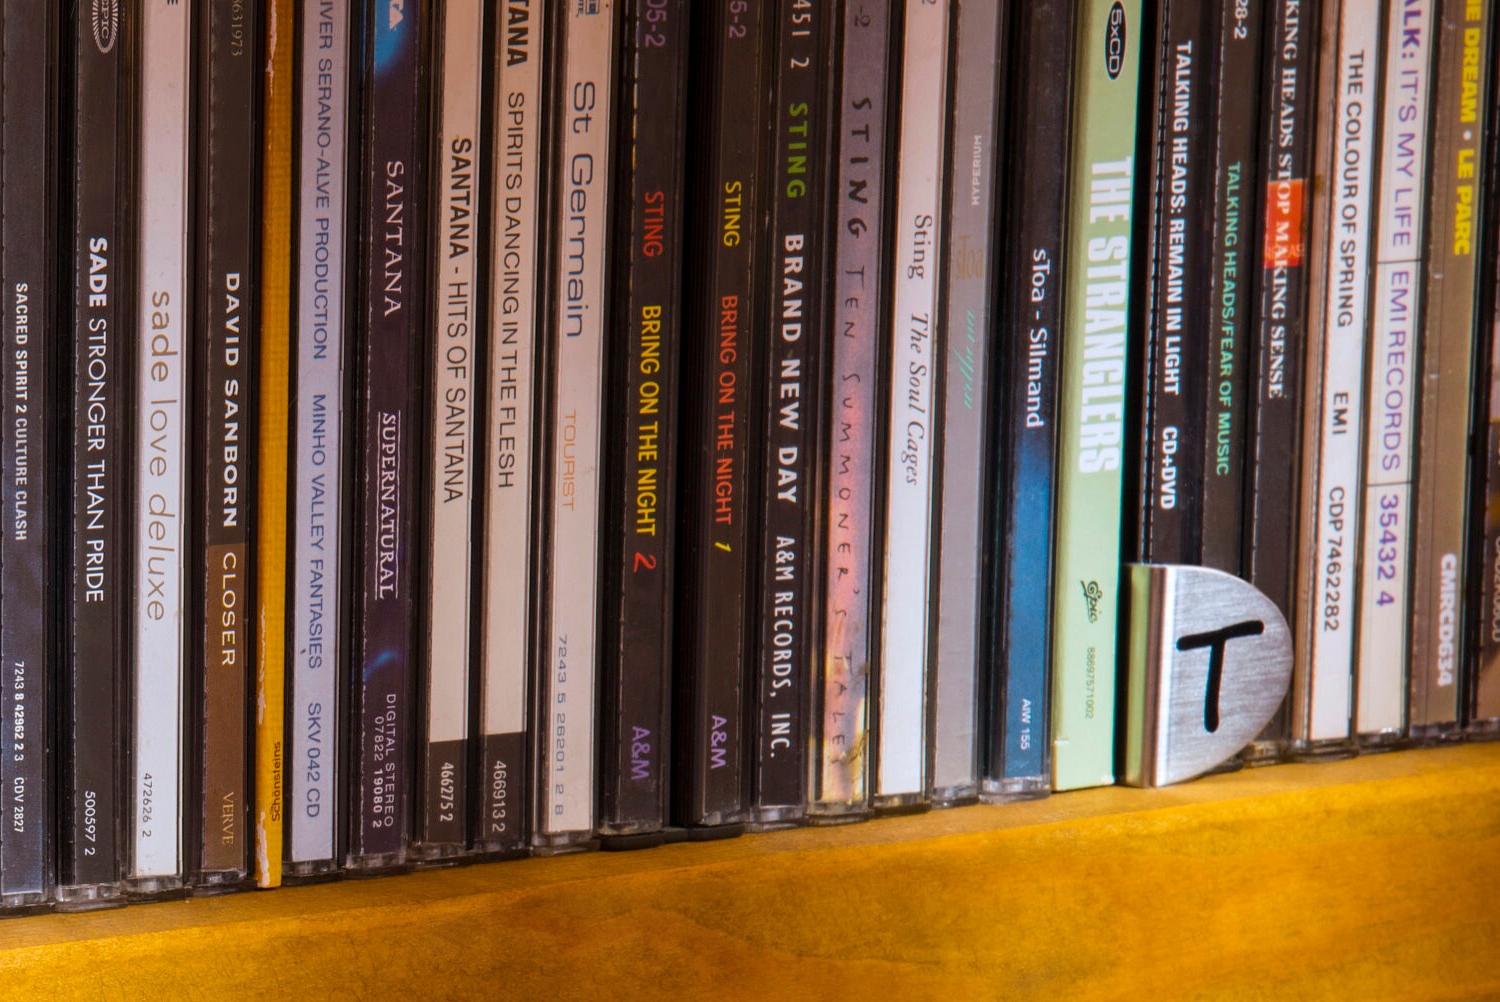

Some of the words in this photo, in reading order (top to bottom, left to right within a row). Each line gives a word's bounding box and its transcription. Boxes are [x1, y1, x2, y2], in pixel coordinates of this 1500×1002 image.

[1108, 8, 1123, 75] 5xCD
[1346, 49, 1365, 96] THE
[1459, 27, 1481, 123] DREAM
[572, 81, 596, 134] St
[1172, 40, 1193, 132] TALKING
[1397, 66, 1418, 123] IT'S
[315, 57, 333, 209] SERANO-ALVE
[786, 102, 808, 199] STING
[846, 96, 873, 240] STING
[1342, 101, 1363, 200] COLOUR
[1396, 132, 1415, 179] MY
[971, 134, 982, 206] HYPERIUM
[1089, 155, 1134, 224] THE
[1169, 136, 1191, 214] HEADS:
[383, 160, 405, 317] SANTANA
[566, 153, 594, 338] Germain
[643, 191, 665, 258] STING
[907, 214, 933, 280] Sting
[1340, 204, 1358, 234] OF
[1392, 187, 1413, 248] LIFE
[1454, 185, 1474, 256] PARC
[89, 237, 108, 307] SADE
[312, 217, 330, 360] PRODUCTION
[781, 233, 805, 344] BRAND
[1166, 218, 1186, 304] REMAIN
[1337, 239, 1357, 329] SPRING
[16, 282, 29, 346] SACRED
[150, 290, 179, 383] sade
[225, 272, 241, 367] DAVID
[843, 265, 867, 339] TEN
[909, 312, 929, 355] The
[1165, 308, 1183, 331] IN
[15, 349, 28, 401] SPIRIT
[640, 305, 662, 375] BRING
[1078, 235, 1129, 475] STRANGLERS
[1163, 336, 1183, 396] LIGHT
[87, 317, 107, 452] STRONGER
[639, 381, 660, 414] ON
[779, 358, 801, 430] NEW
[908, 361, 927, 415] Soul
[1026, 328, 1048, 429] Silmand
[1332, 391, 1349, 436] EMI
[1381, 330, 1407, 472] RECORDS
[15, 418, 28, 487] CULTURE
[149, 398, 178, 478] love
[223, 379, 240, 528] SANBORN
[310, 394, 327, 466] MINHO
[561, 409, 577, 512] TOURIST
[638, 421, 658, 462] THE
[900, 421, 925, 486] Cages
[86, 459, 105, 530] THAN
[636, 468, 657, 537] NIGHT
[777, 446, 799, 504] DAY
[1159, 425, 1180, 510] CD+DVD
[14, 492, 28, 541] CLASH
[310, 473, 326, 551] VALLEY
[378, 411, 398, 600] SUPERNATURAL
[1327, 486, 1345, 532] CDP
[85, 538, 105, 603] PRIDE
[146, 493, 176, 621] deluxe
[1323, 536, 1343, 632] 7462282
[220, 551, 237, 667] CLOSER
[308, 558, 324, 670] FANTASIES
[1436, 554, 1458, 688] CMRCD634
[1176, 619, 1265, 733] T
[385, 693, 397, 756] DIGITAL
[13, 777, 25, 803] CDV
[13, 806, 24, 834] 2827
[84, 790, 97, 843] 500597
[221, 791, 235, 846] VERVE
[383, 762, 396, 828] STEREO
